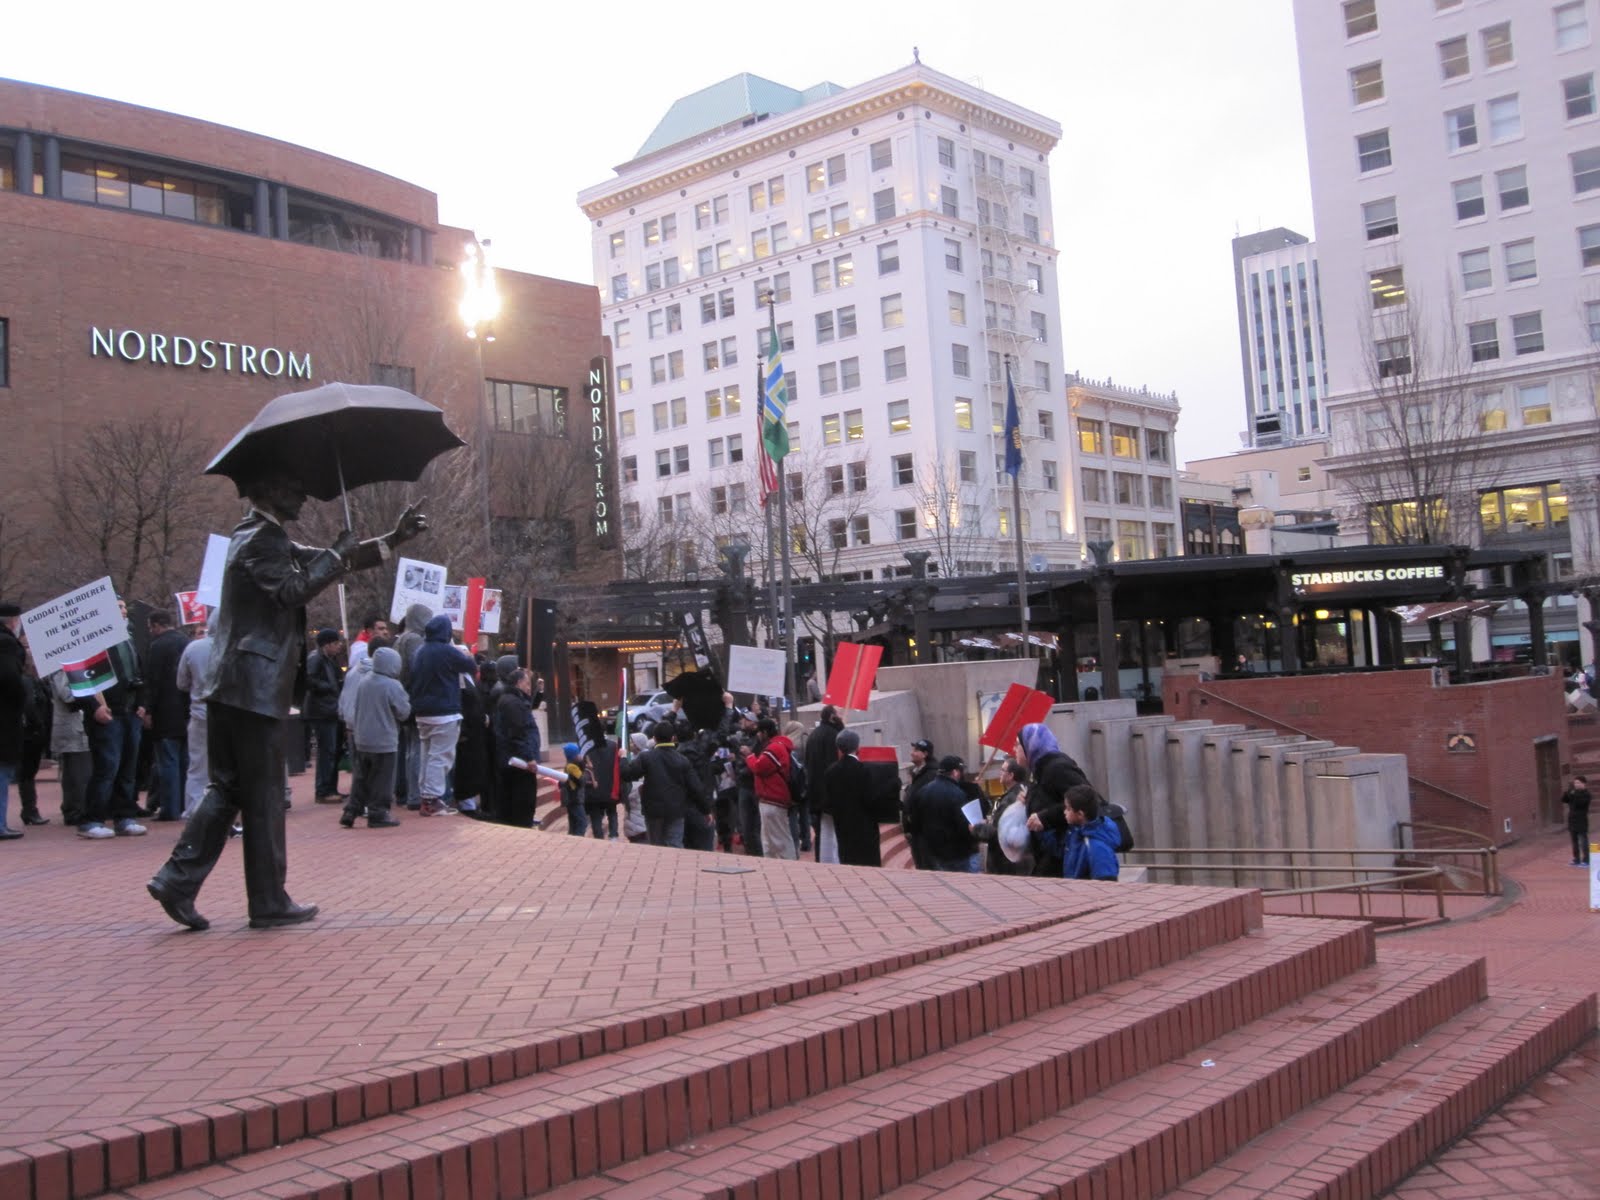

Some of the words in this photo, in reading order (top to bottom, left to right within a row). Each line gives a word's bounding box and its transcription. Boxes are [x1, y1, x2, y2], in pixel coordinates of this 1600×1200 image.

[91, 326, 312, 379] NORDSTROM
[589, 369, 608, 536] NORDSTROM
[1291, 569, 1384, 586] STARBUCKS
[1386, 566, 1444, 580] COFFEE
[27, 605, 59, 625] GADDAFI
[64, 584, 106, 607] MURDERER
[59, 606, 79, 621] STOP
[45, 627, 60, 638] THE
[61, 608, 99, 631] MASSACRE
[70, 627, 80, 637] OF
[44, 639, 81, 659] INNOCENT
[82, 624, 113, 643] LIBYANS
